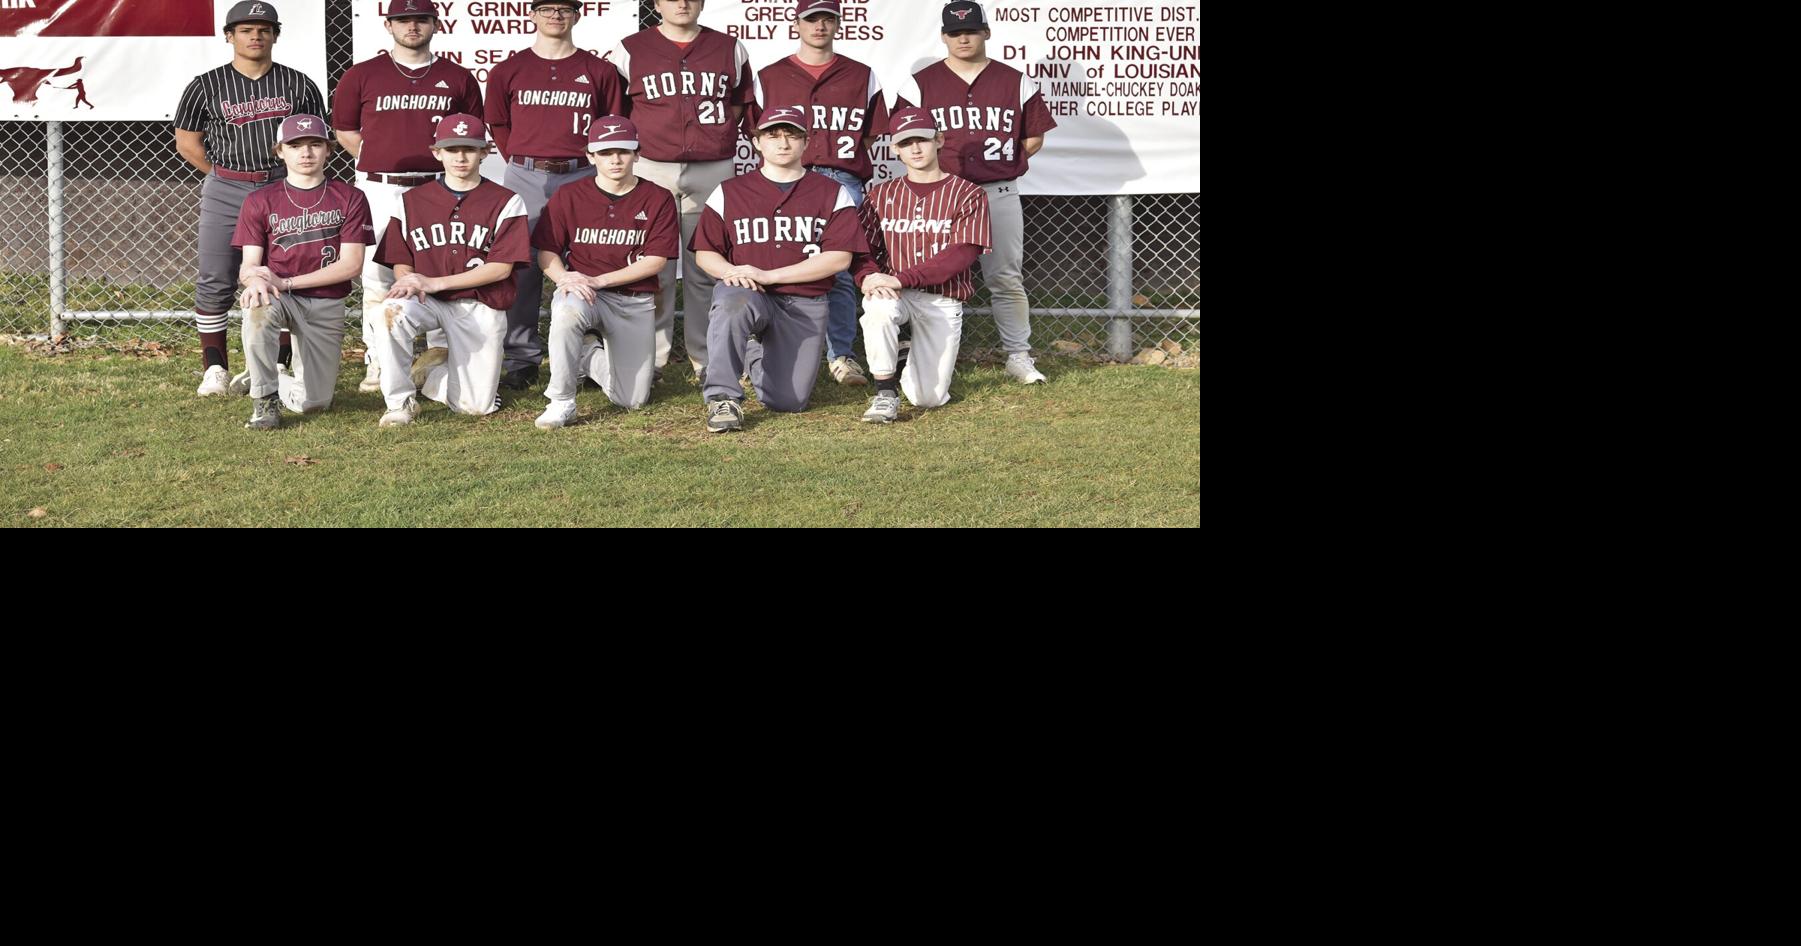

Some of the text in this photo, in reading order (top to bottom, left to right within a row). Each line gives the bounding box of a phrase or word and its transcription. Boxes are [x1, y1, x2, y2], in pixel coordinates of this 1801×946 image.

[745, 7, 798, 21] GREG
[995, 7, 1199, 22] MOST COMPETITIVE DIST.
[471, 19, 538, 34] WARD
[727, 25, 884, 40] BILLY BGESS
[1046, 27, 1195, 42] COMPETITION EVER
[1003, 45, 1026, 60] D1
[1046, 45, 1100, 60] JOHN
[1026, 63, 1071, 78] UNIV
[1086, 64, 1104, 78] of
[642, 71, 729, 100] HORNS
[1051, 82, 1164, 97] MANUEL-CHUCKEY
[375, 94, 453, 112] LONGHORNS
[517, 90, 592, 109] LONGHORNS
[1087, 101, 1154, 116] COLLEGE
[1162, 101, 1200, 116] PLAY
[698, 100, 726, 125] 21
[931, 105, 1015, 133] HORNS
[573, 112, 592, 137] 12
[837, 135, 855, 159] 2
[983, 137, 1014, 161] 24
[269, 208, 346, 236] Longhorns
[734, 216, 827, 245] HORNS
[880, 217, 953, 234] HORNS
[410, 221, 491, 252] HORN
[574, 228, 647, 246] LONGHORNS
